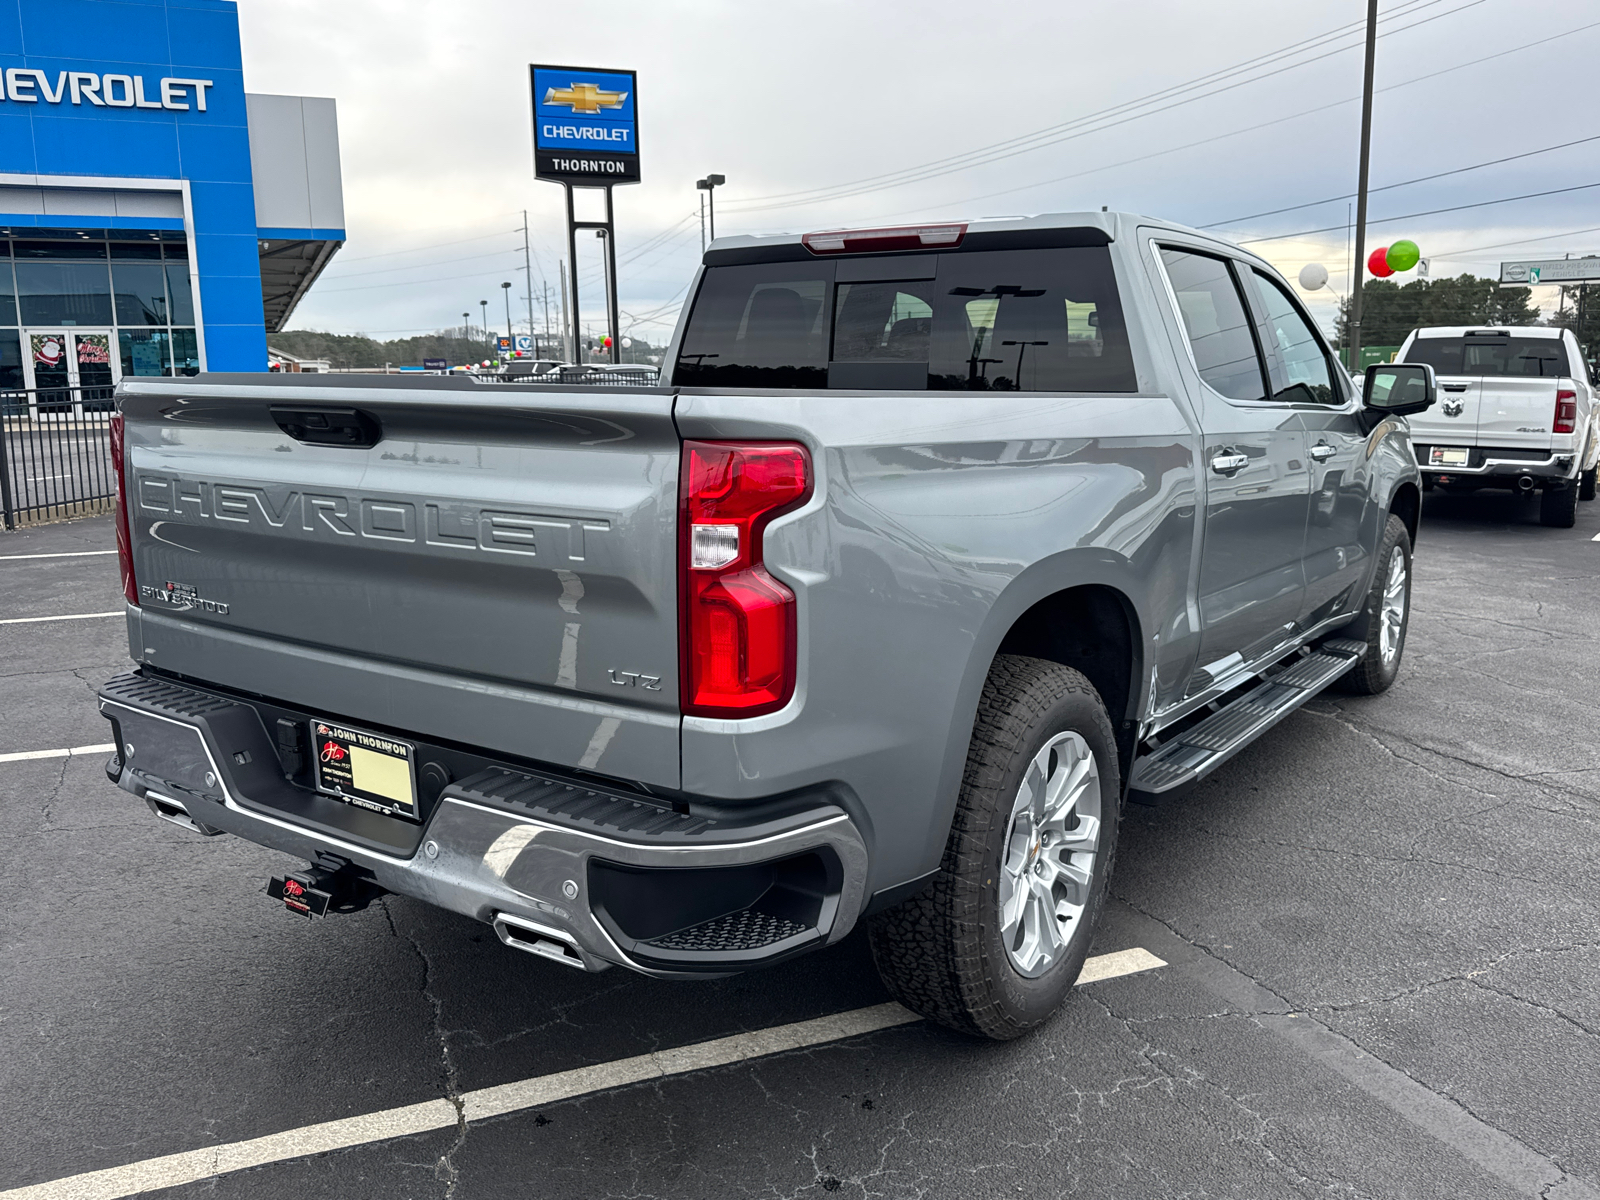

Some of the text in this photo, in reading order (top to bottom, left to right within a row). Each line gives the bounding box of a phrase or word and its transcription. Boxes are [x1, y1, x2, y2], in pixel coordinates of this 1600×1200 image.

[0, 67, 213, 111] EVROLET
[543, 125, 630, 141] CHEVROLET
[552, 158, 625, 173] THORNTON
[140, 475, 610, 561] CHEVROLET
[142, 585, 230, 615] SILVERADO
[607, 669, 662, 691] LTZ
[333, 728, 407, 756] JOHN THORNTON
[352, 798, 382, 812] CHEVROLET
